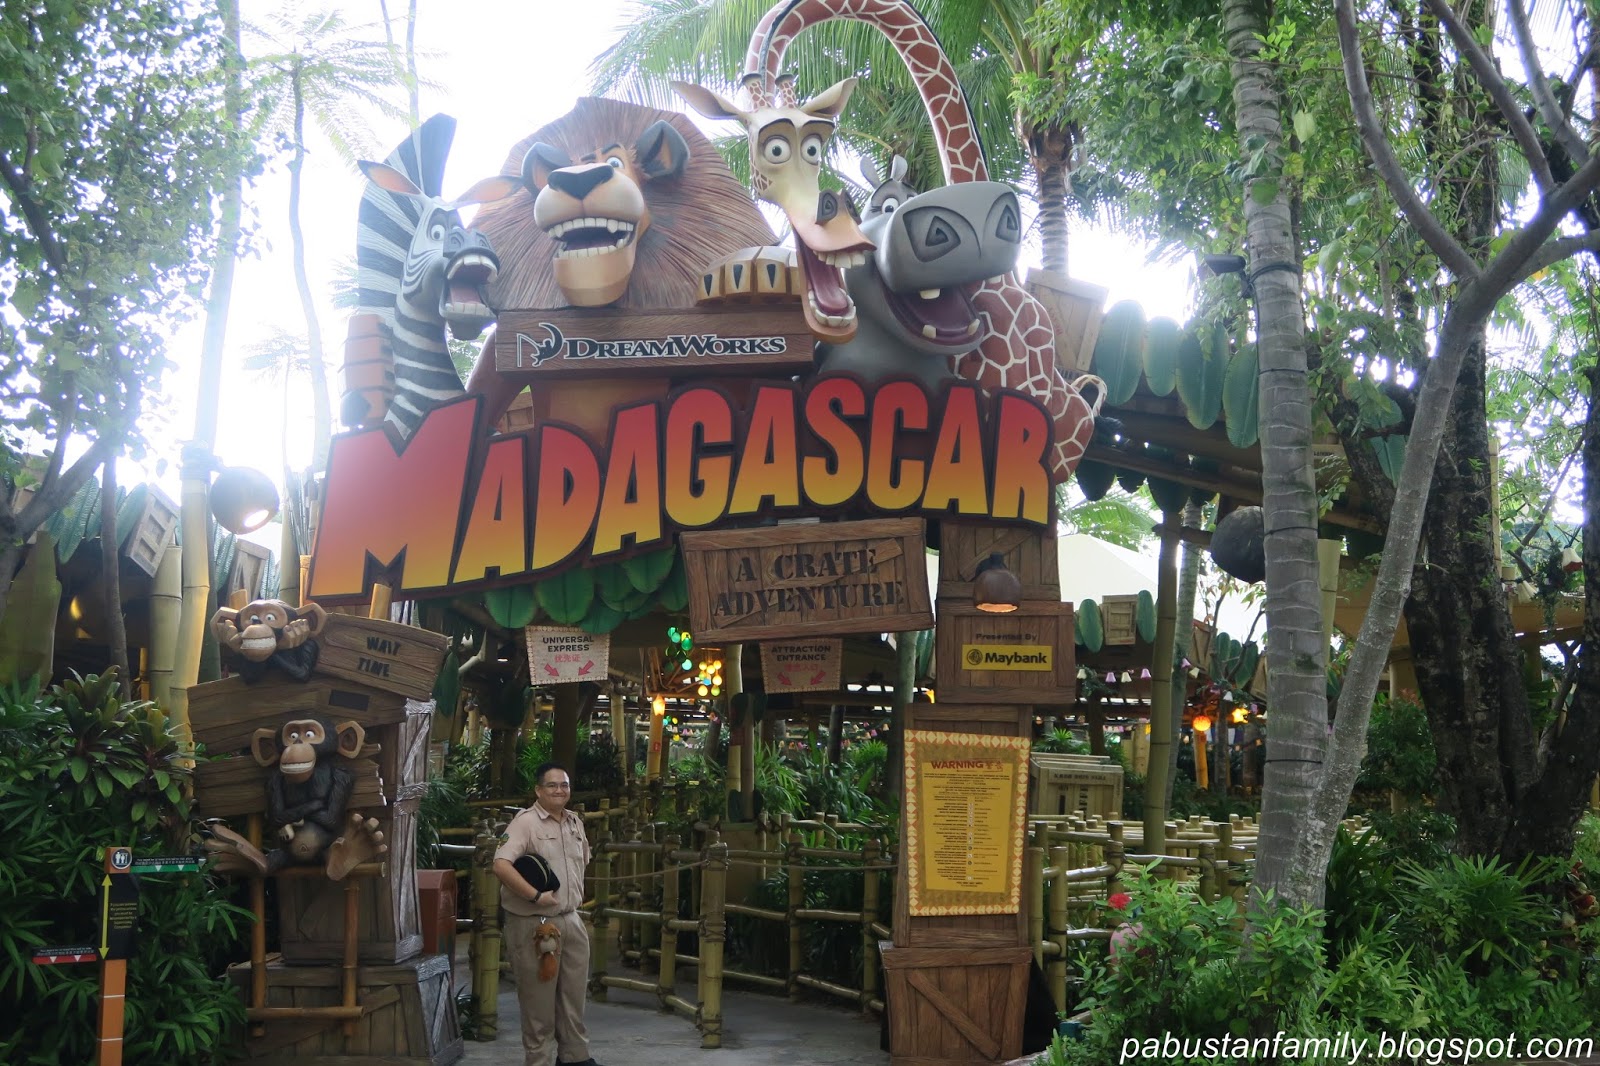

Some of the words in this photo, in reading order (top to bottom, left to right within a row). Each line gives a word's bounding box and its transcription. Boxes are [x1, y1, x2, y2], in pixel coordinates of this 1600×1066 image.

[308, 377, 1051, 598] MADAGASCAR
[735, 555, 758, 583] A
[774, 548, 879, 581] CRATE
[714, 580, 905, 617] ADVENTURE
[542, 635, 594, 644] UNIVERSAL
[1025, 633, 1038, 642] By
[547, 644, 590, 653] EXPRESS
[771, 645, 832, 653] ATTRACTION
[776, 653, 827, 662] ENTRANCE
[985, 651, 1047, 665] Maybank
[357, 655, 391, 678] TIME
[930, 760, 984, 770] WARNING
